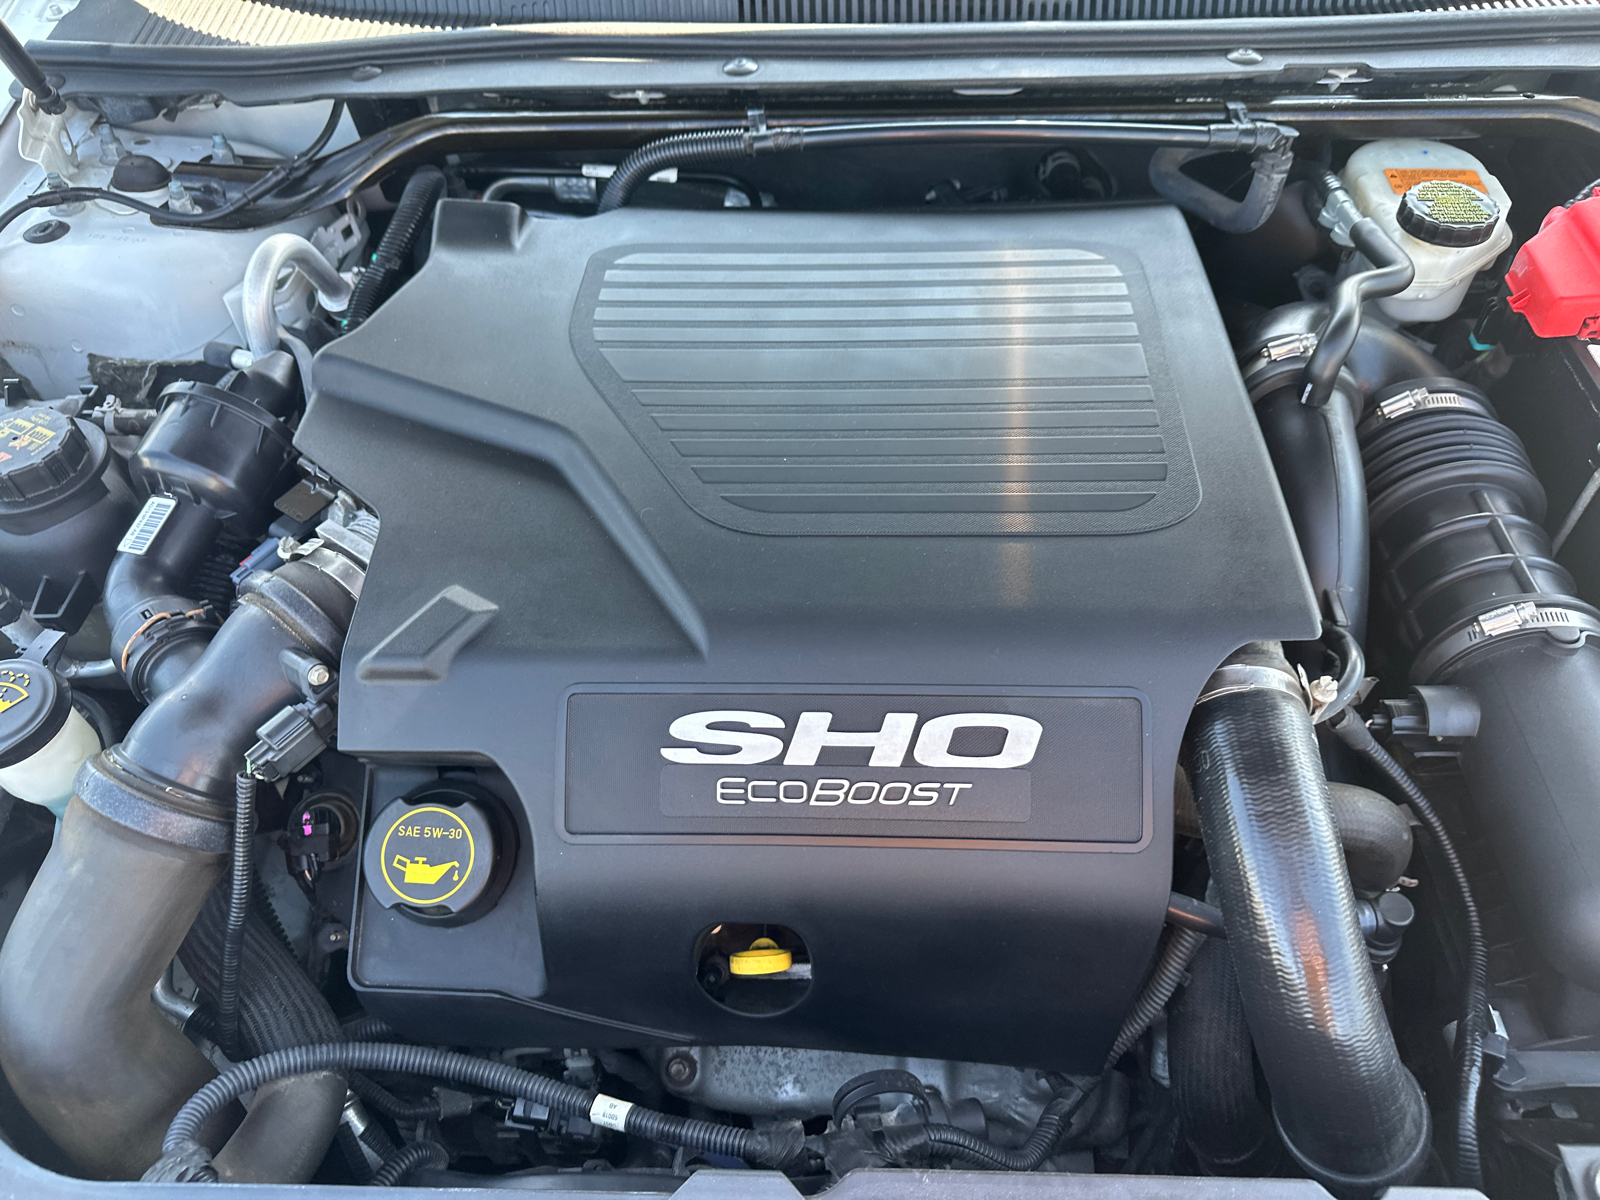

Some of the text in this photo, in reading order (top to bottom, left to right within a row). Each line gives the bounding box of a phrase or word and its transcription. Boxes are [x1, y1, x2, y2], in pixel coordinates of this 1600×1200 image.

[659, 710, 1044, 770] SHO
[398, 825, 463, 840] SAE 5W-30
